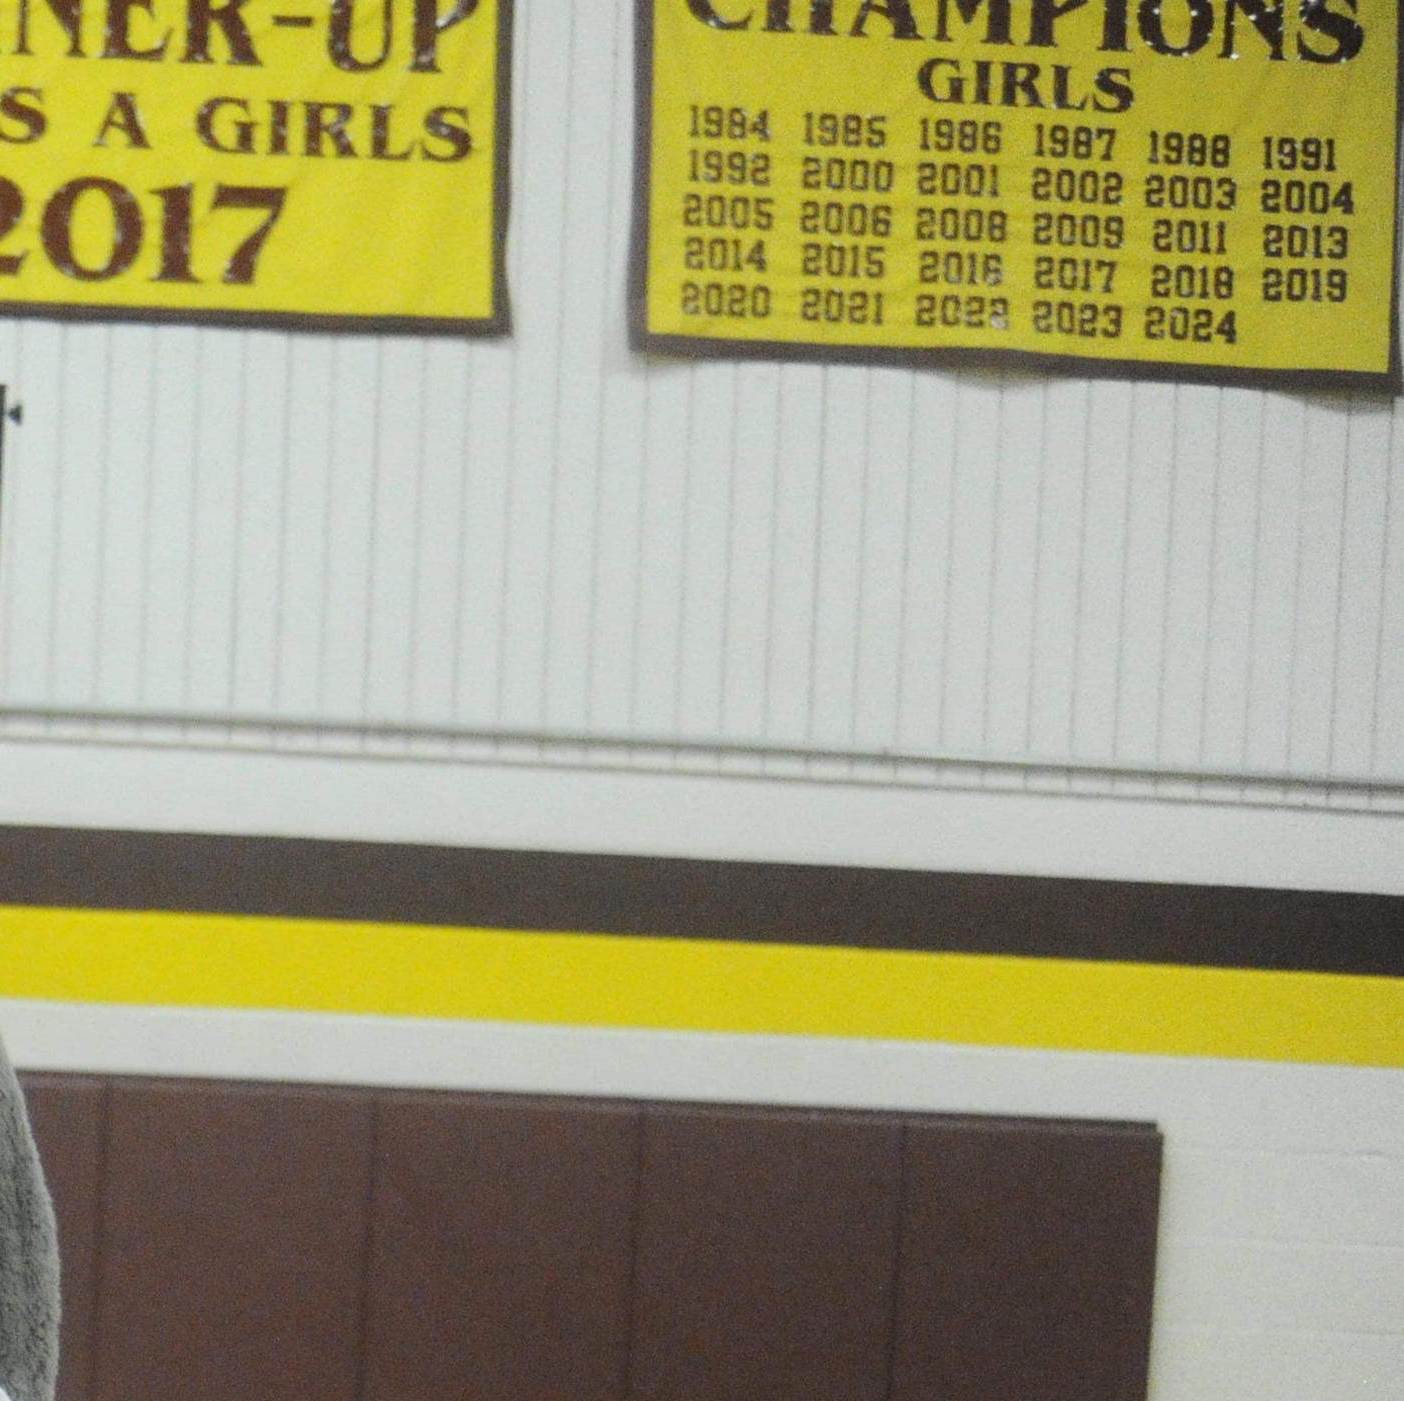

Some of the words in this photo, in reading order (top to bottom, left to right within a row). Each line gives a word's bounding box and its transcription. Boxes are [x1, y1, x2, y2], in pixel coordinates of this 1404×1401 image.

[917, 57, 1136, 114] GIRLS
[91, 91, 153, 149] A
[195, 96, 475, 163] GIRLS
[689, 105, 771, 141] 1984
[804, 112, 887, 149] 1985
[920, 118, 1003, 154] 1986
[1035, 124, 1117, 161] 1987
[1148, 130, 1232, 168] 1988
[1263, 136, 1338, 172] 1991
[689, 149, 771, 186] 1992
[803, 156, 895, 193] 2000
[917, 162, 1000, 198] 2001
[1031, 167, 1124, 205] 2002
[1145, 174, 1238, 211] 2003
[1261, 179, 1355, 215] 2004
[683, 193, 774, 231] 2005
[800, 201, 893, 238] 2006
[916, 207, 1009, 243] 2008
[1033, 212, 1125, 249] 2009
[1152, 218, 1228, 254] 2011
[1263, 223, 1350, 259] 2013
[685, 236, 768, 273] 2014
[802, 242, 886, 279] 2015
[920, 251, 1003, 286] 2016
[1034, 256, 1118, 293] 2017
[1150, 264, 1235, 299] 2018
[1262, 267, 1349, 303] 2019
[682, 282, 772, 318] 2020
[801, 288, 884, 325] 2021
[915, 294, 1010, 329] 2022
[1033, 300, 1123, 338] 2023
[1145, 306, 1238, 344] 2024
